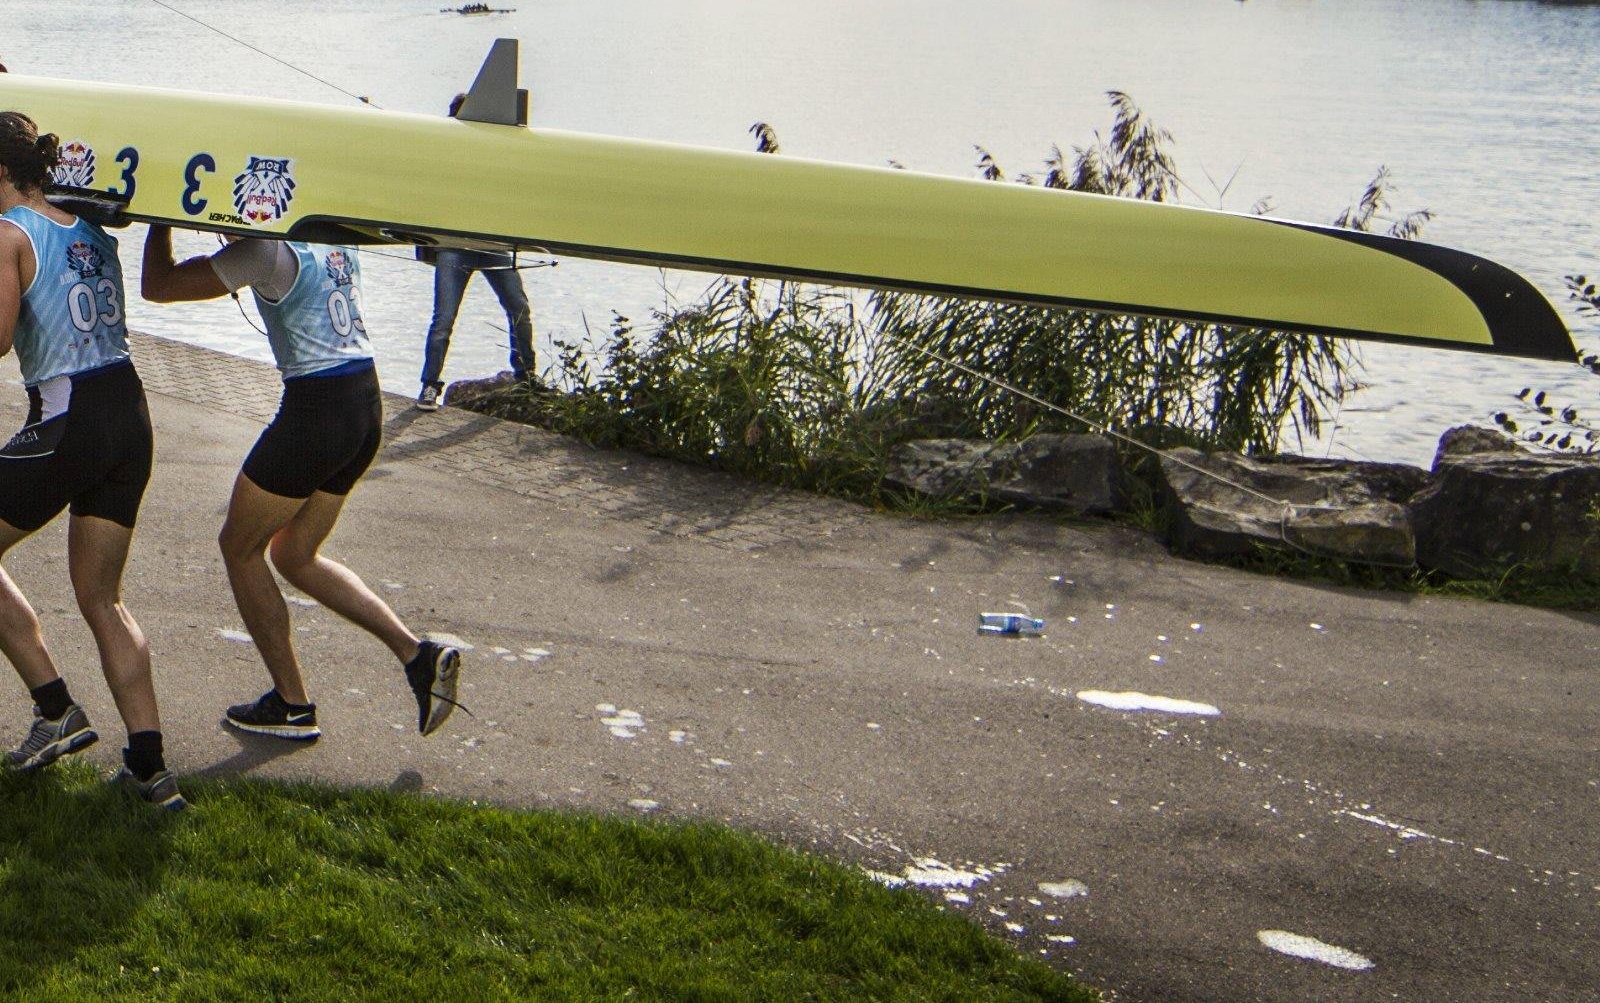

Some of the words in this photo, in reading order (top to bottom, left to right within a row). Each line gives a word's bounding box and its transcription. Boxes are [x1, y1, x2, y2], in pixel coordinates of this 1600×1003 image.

[108, 146, 140, 201] 3
[256, 161, 280, 171] ROW
[182, 153, 216, 215] 3
[246, 194, 262, 205] Bull
[262, 195, 277, 207] Red
[209, 212, 251, 225] PACHER
[67, 278, 121, 332] 03
[327, 286, 365, 337] 03
